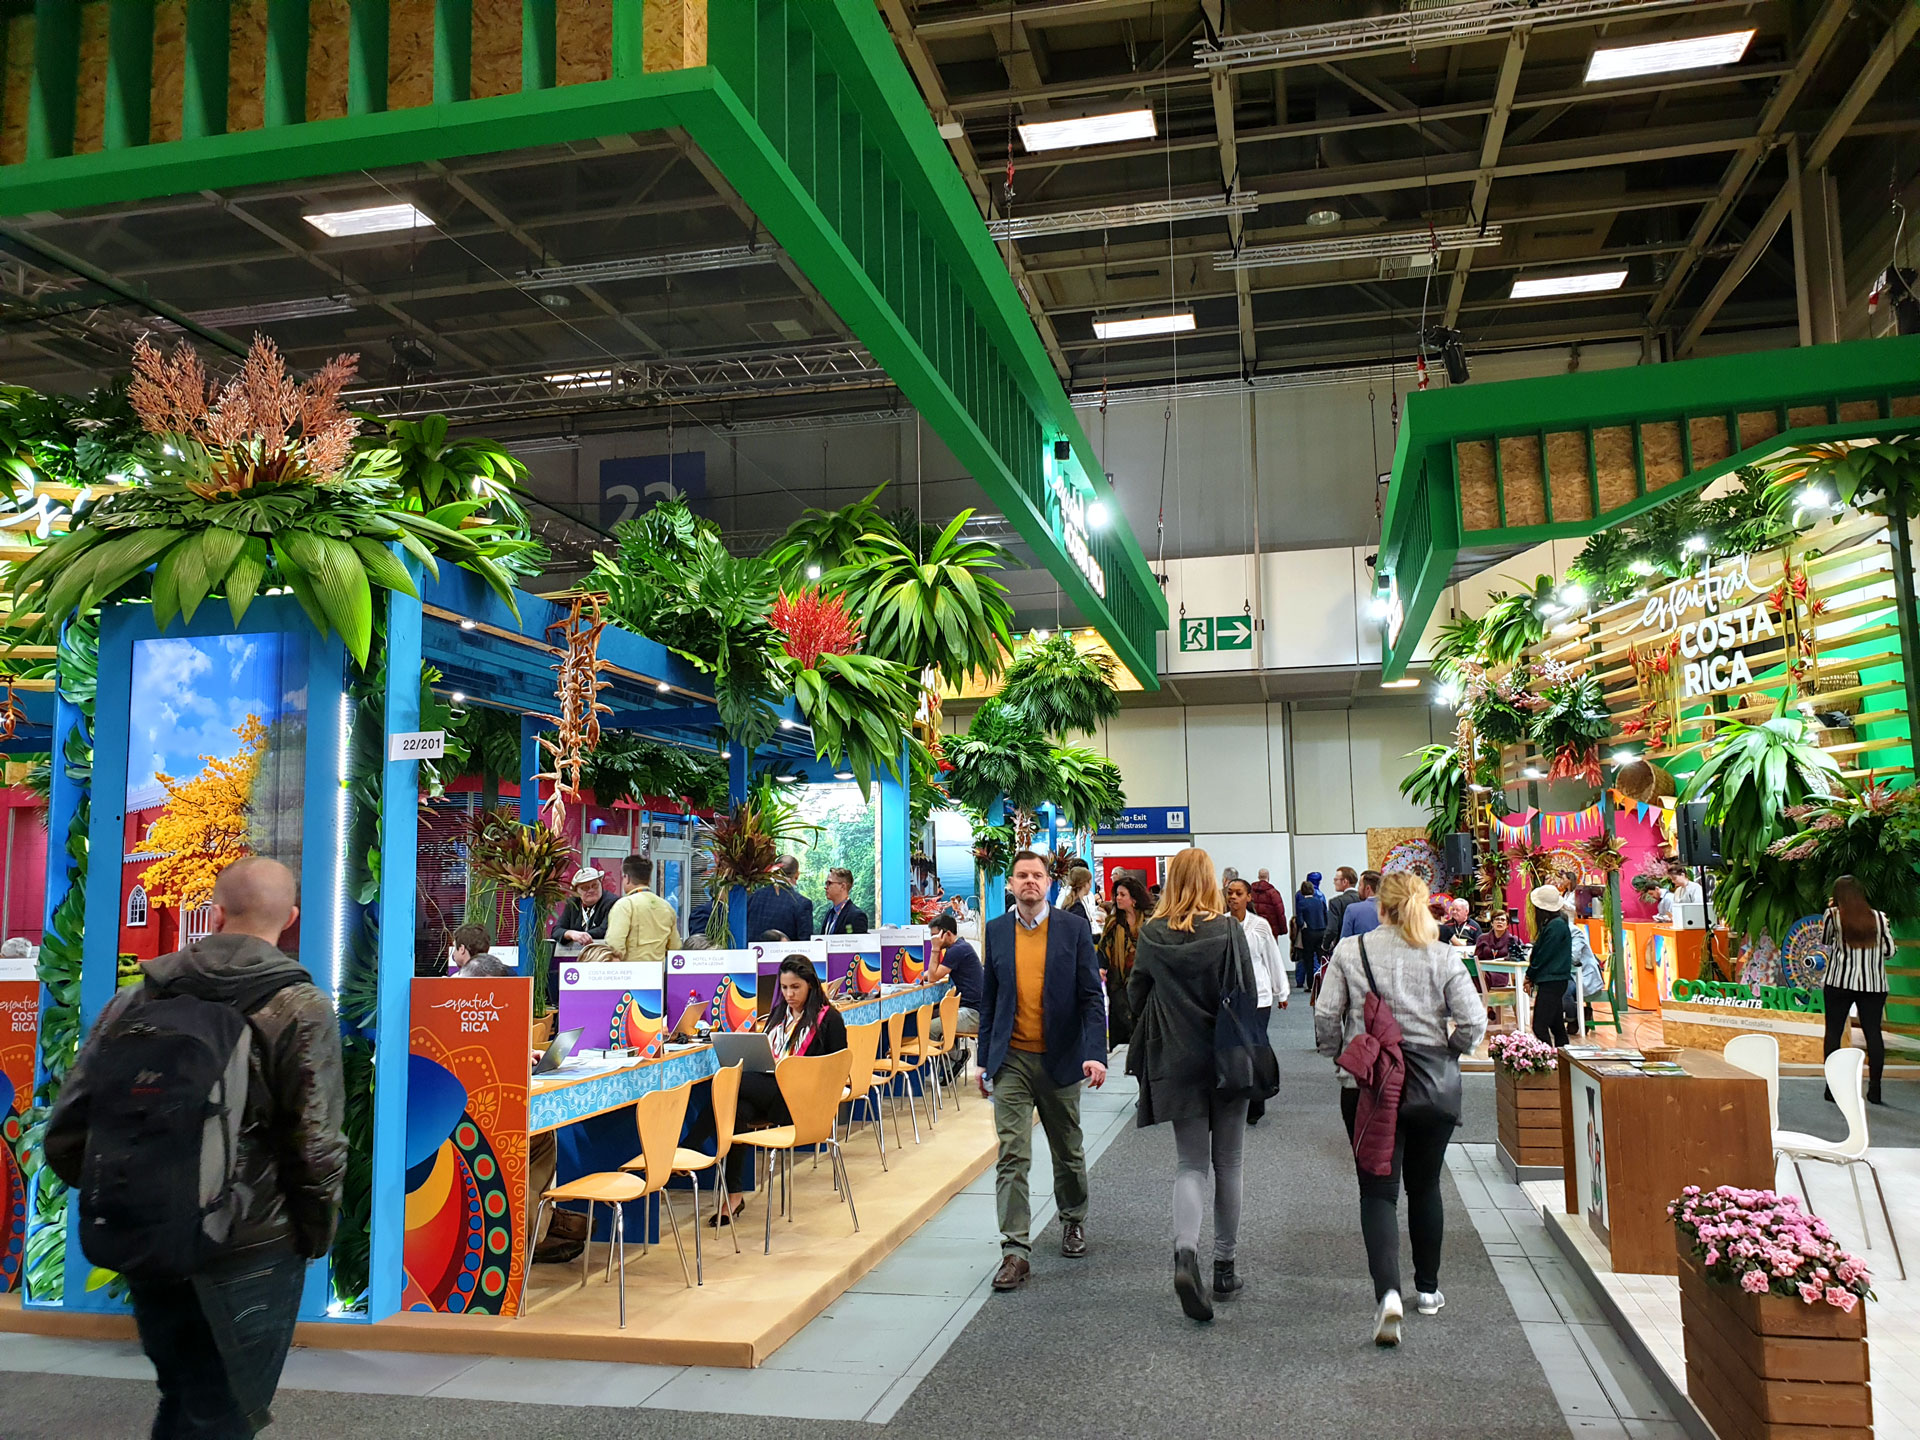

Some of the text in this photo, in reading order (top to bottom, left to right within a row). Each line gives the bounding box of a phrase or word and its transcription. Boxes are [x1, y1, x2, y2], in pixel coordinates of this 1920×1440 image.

[1617, 551, 1785, 635] essential
[1680, 603, 1776, 658] COSTA
[1684, 650, 1753, 697] RICA
[403, 738, 440, 750] 22/201
[673, 959, 684, 967] 25
[566, 972, 578, 981] 26
[1672, 978, 1825, 1013] COSTA RICA
[1690, 994, 1763, 1009] #CostaRicaITB
[0, 995, 39, 1013] essentia
[431, 992, 504, 1012] essential
[12, 1012, 39, 1021] COST
[461, 1011, 500, 1021] COSTA
[11, 1022, 36, 1032] RICA
[461, 1022, 490, 1032] RICA
[1710, 1017, 1773, 1029] #PuraVida #CostaRica
